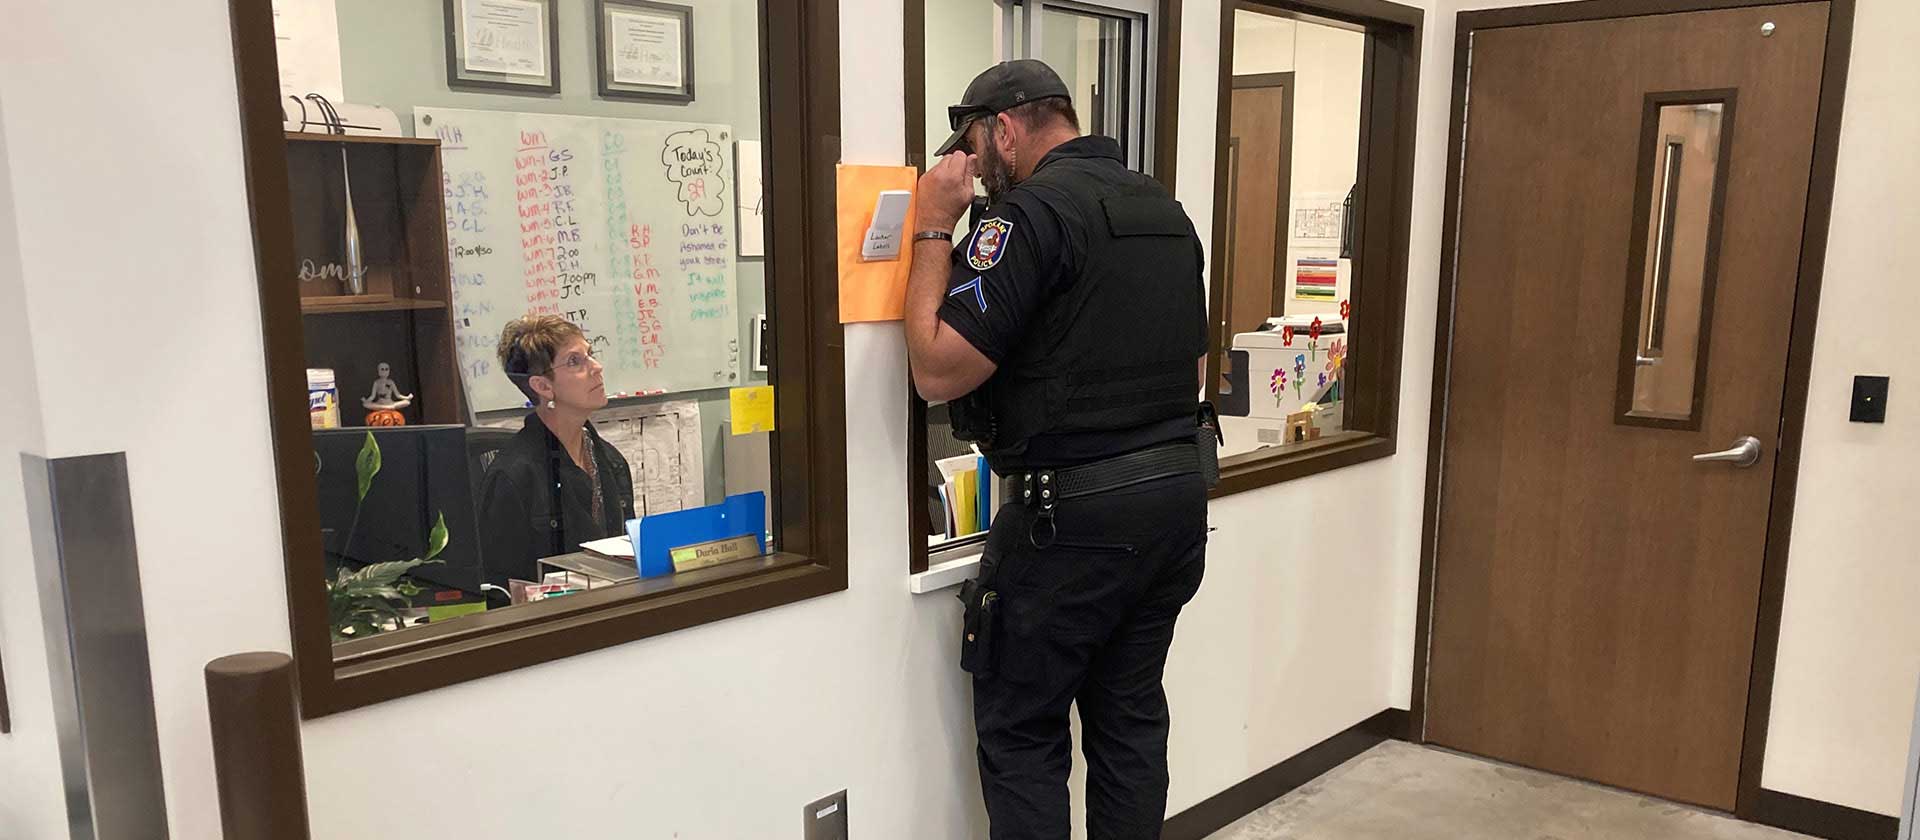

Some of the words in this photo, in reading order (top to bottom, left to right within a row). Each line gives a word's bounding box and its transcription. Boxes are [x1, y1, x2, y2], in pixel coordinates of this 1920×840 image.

[671, 146, 713, 167] Today's
[687, 178, 707, 201] 29
[682, 223, 708, 237] Don't
[980, 221, 1006, 234] SPOKANE
[971, 255, 993, 267] POLICE
